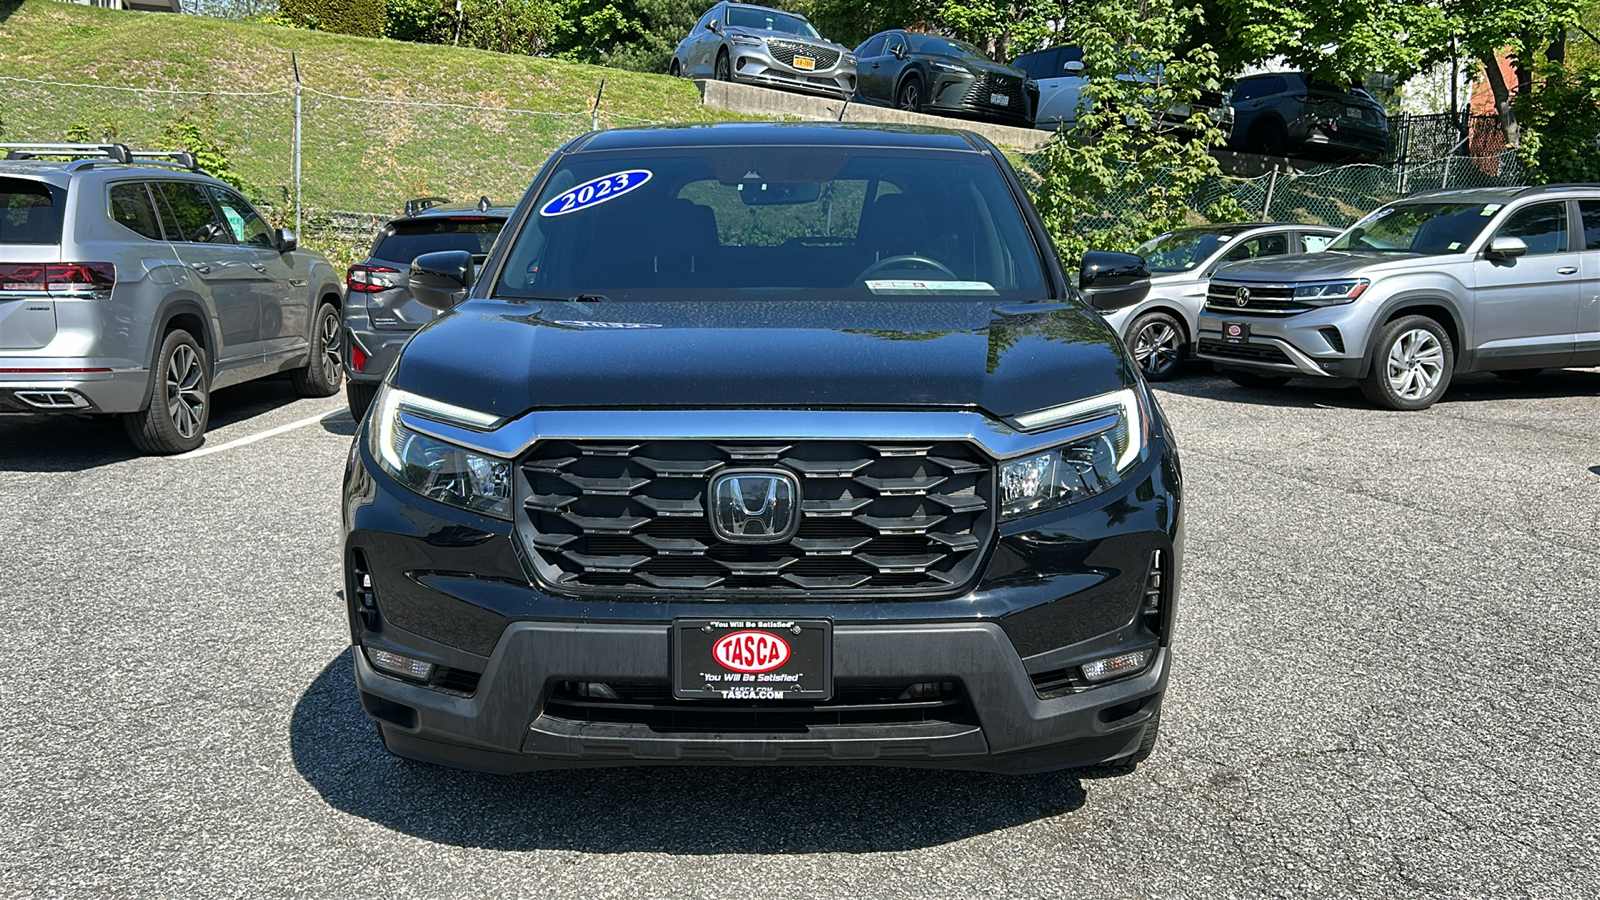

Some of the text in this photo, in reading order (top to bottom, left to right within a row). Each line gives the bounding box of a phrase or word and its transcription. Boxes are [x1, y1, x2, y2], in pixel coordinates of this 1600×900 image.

[559, 173, 629, 212] 2023
[722, 635, 780, 667] TASCA
[699, 673, 803, 682] "You Will Be Satisfied"
[721, 691, 783, 700] TASCA.COM
